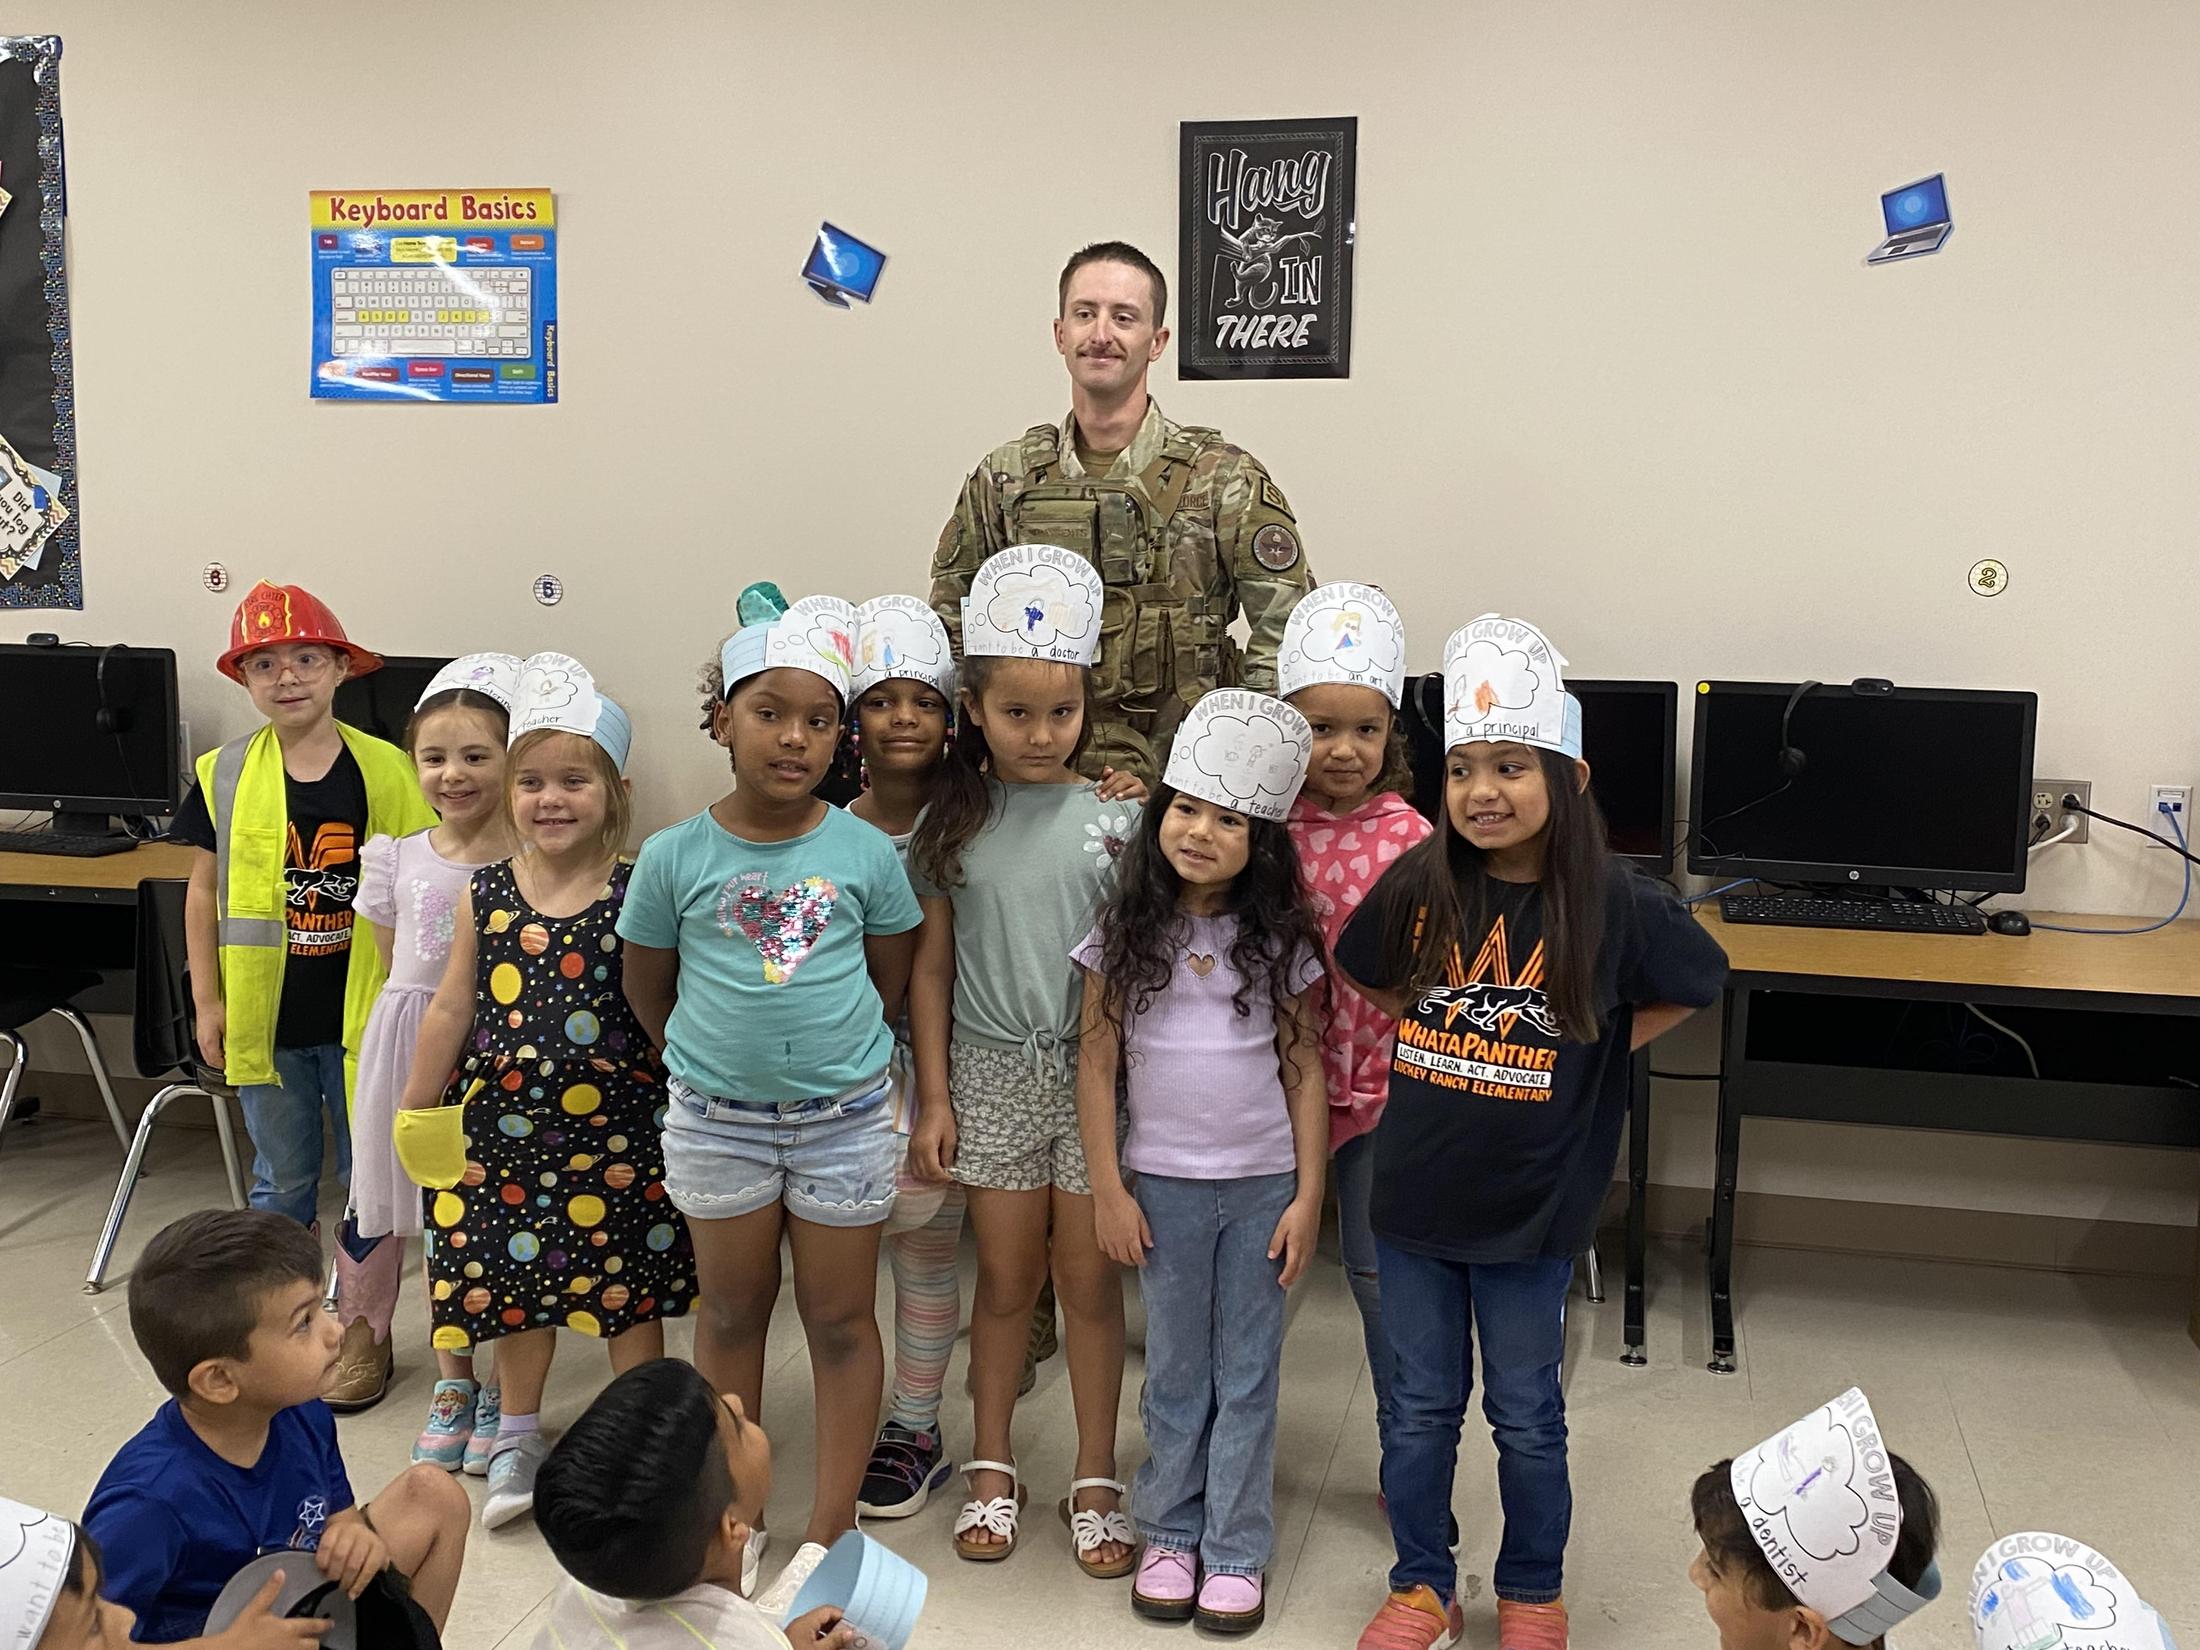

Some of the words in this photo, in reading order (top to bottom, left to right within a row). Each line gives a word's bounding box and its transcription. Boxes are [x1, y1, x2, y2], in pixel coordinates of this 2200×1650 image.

[1207, 148, 1332, 229] Hang
[330, 196, 448, 228] Keyboard
[461, 195, 537, 220] Basics
[1280, 255, 1322, 305] IN
[545, 325, 555, 368] Keyboard
[1216, 314, 1318, 349] THERE
[546, 371, 556, 398] Basics
[0, 494, 13, 514] ou
[13, 513, 29, 535] log
[13, 491, 31, 513] Did
[977, 547, 1023, 587] WHEN
[1027, 547, 1033, 562] I
[1038, 546, 1092, 579] GROW
[1088, 574, 1102, 598] UP
[1978, 567, 1997, 588] 2
[793, 596, 844, 617] WHEN
[878, 596, 931, 617] GROW
[930, 619, 945, 638] UP
[1290, 586, 1336, 626] WHEN
[1339, 585, 1345, 598] I
[1348, 584, 1394, 617] GROW
[1393, 619, 1403, 639] UP
[1031, 646, 1039, 657] a
[1049, 645, 1080, 660] doctor
[1463, 628, 1469, 643] I
[1471, 621, 1530, 645] GROW
[1528, 641, 1548, 665] UP
[884, 670, 892, 678] a
[1348, 671, 1363, 682] an
[1194, 693, 1244, 722] WHEN
[1248, 695, 1255, 711] I
[1259, 698, 1309, 736] GROW
[1301, 734, 1312, 754] UP
[1466, 725, 1474, 737] a
[1483, 722, 1540, 742] principal
[1230, 799, 1239, 810] a
[1249, 799, 1285, 818] teacher
[1429, 1070, 1469, 1092] RANCH
[1471, 1079, 1553, 1103] ELEMENTARY
[1430, 1055, 1463, 1073] LEARN.
[1467, 1063, 1489, 1079] ACT.
[1493, 1068, 1548, 1087] ADVOCATE.
[1851, 1414, 1896, 1502] GROW
[42, 1525, 67, 1545] be
[1740, 1496, 1752, 1508] a
[1752, 1515, 1809, 1588] dentist
[1871, 1512, 1897, 1547] UP
[38, 1549, 62, 1573] to
[1999, 1535, 2081, 1560] GROW
[2084, 1553, 2118, 1580] UP
[17, 1580, 51, 1640] want
